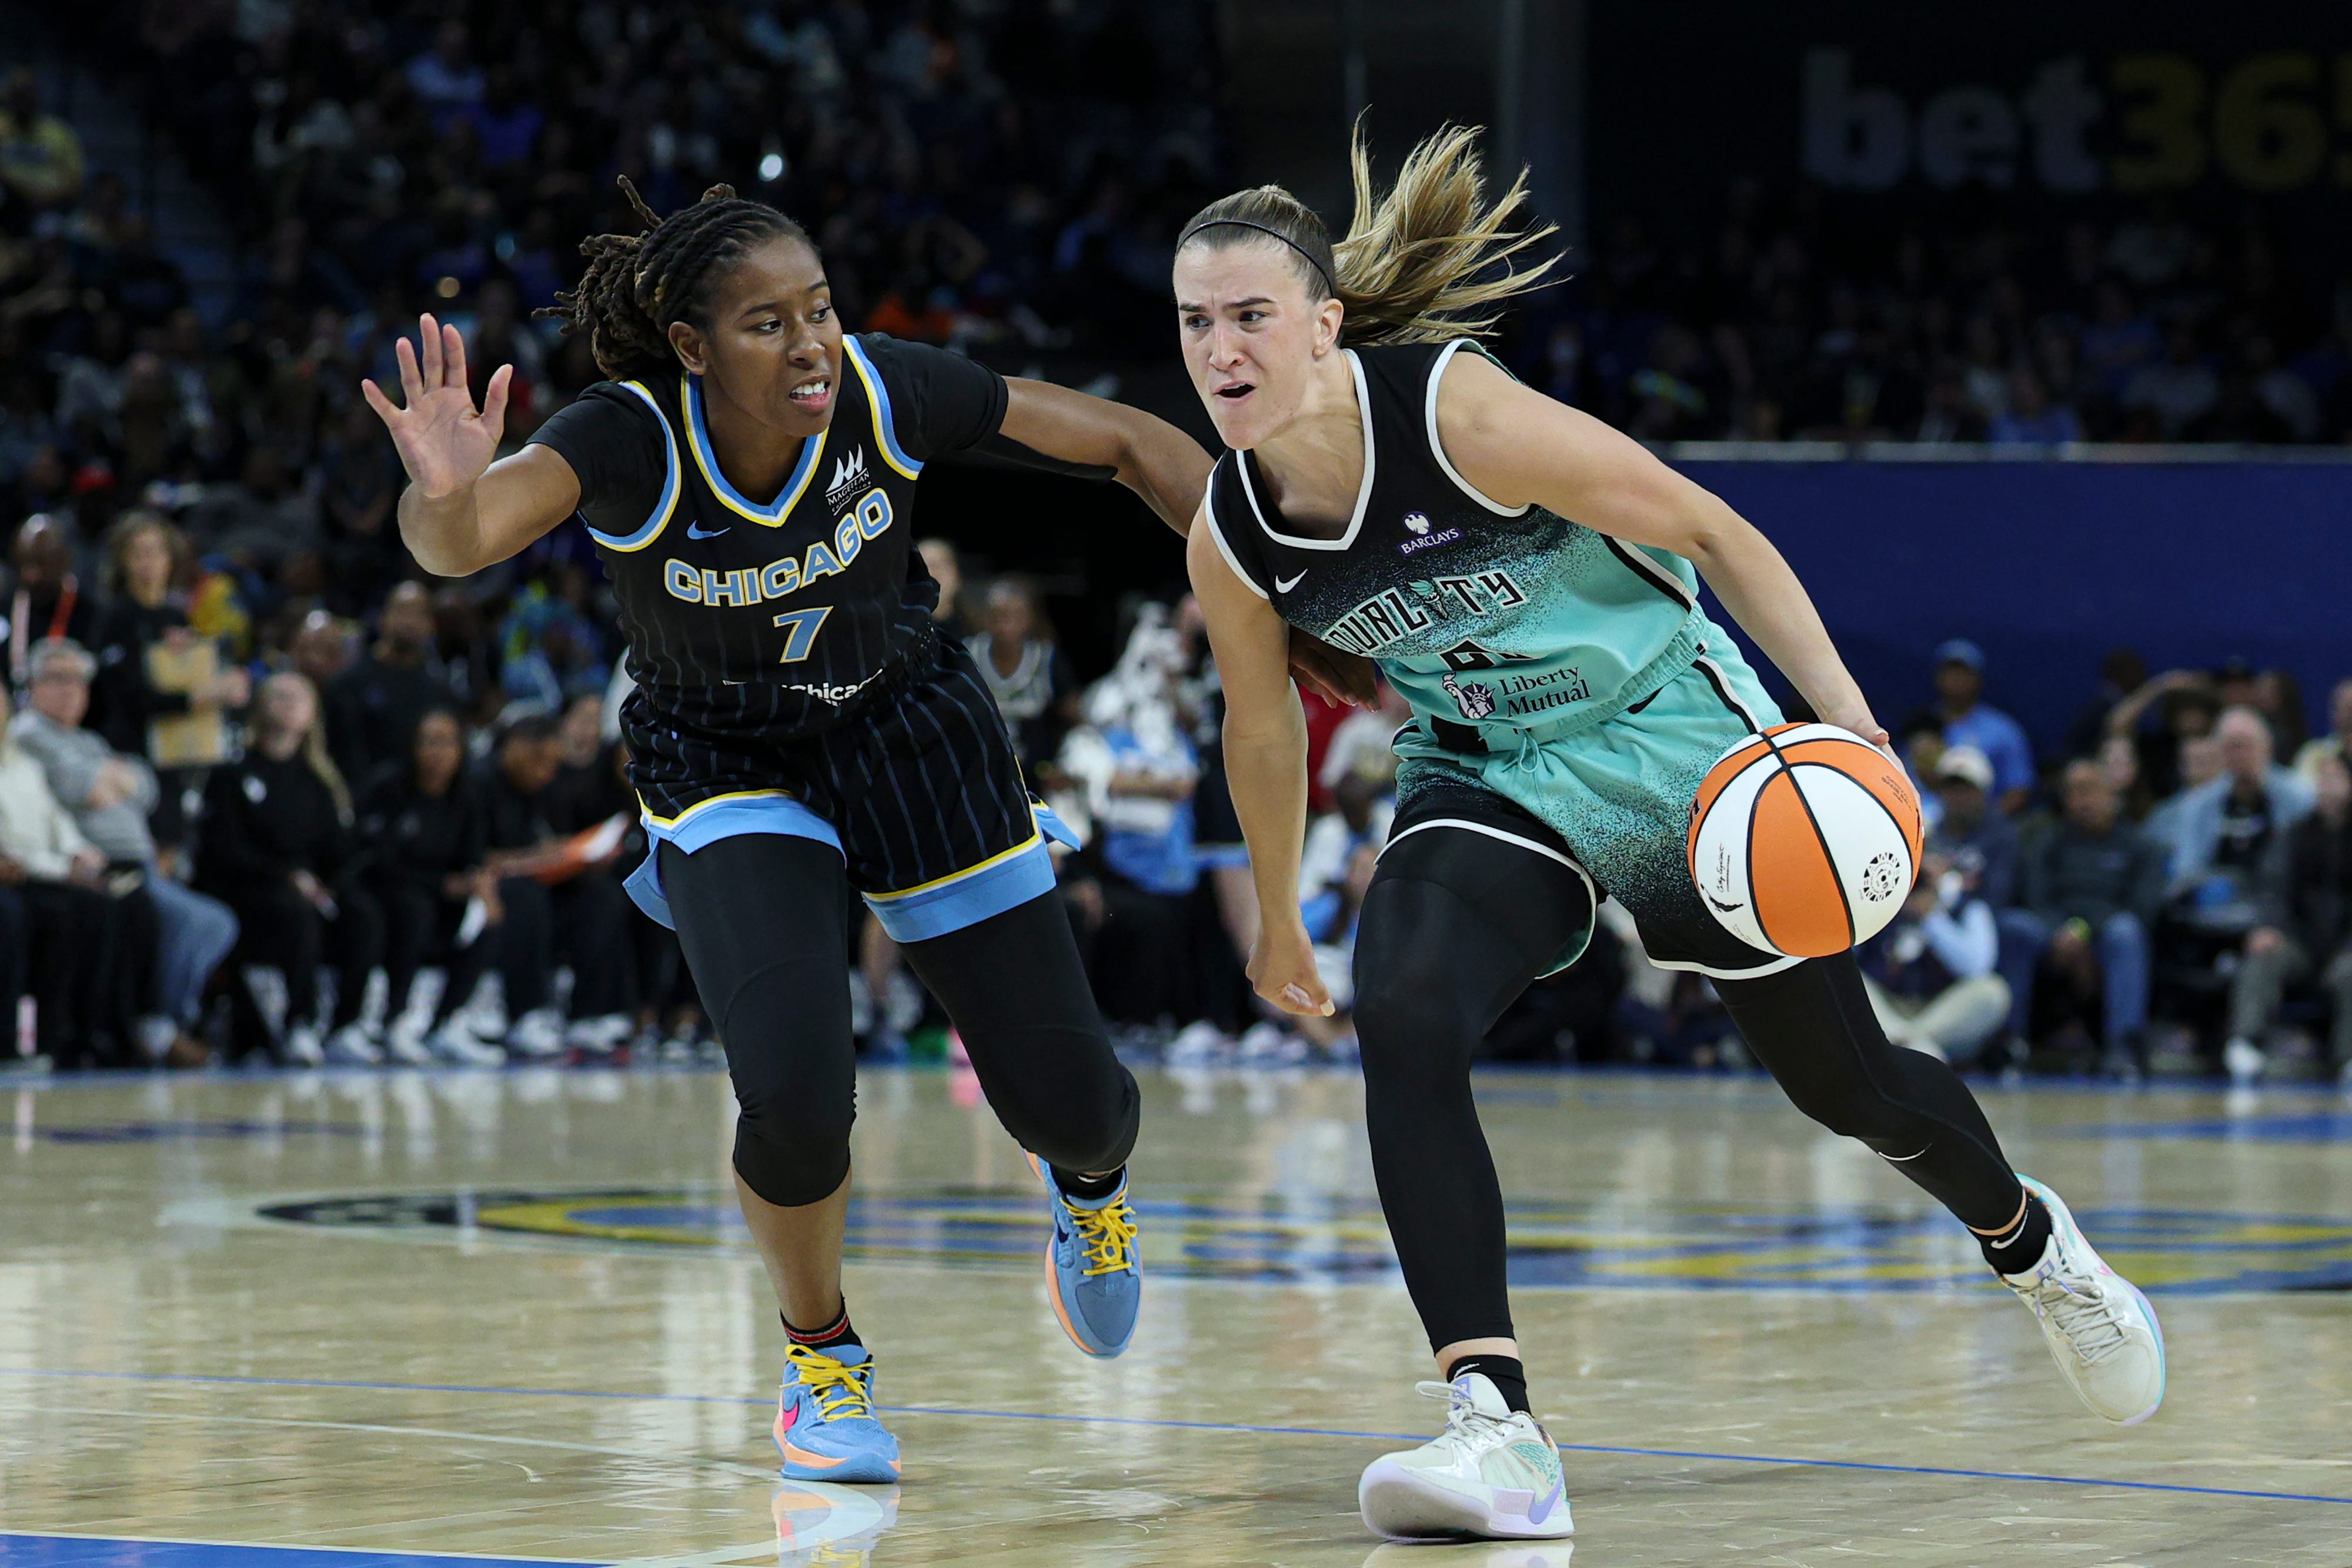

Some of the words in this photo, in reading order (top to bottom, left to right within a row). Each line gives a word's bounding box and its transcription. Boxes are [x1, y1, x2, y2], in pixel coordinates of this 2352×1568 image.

[1799, 44, 2352, 196] bet36
[827, 470, 870, 506] MAGELLAN
[664, 488, 893, 607] CHICAGO
[1401, 529, 1459, 555] BARCLAYS
[773, 606, 834, 663] 7
[1321, 569, 1528, 657] QUALITY
[1499, 667, 1580, 696] Liberty
[1506, 681, 1592, 718] Mutual
